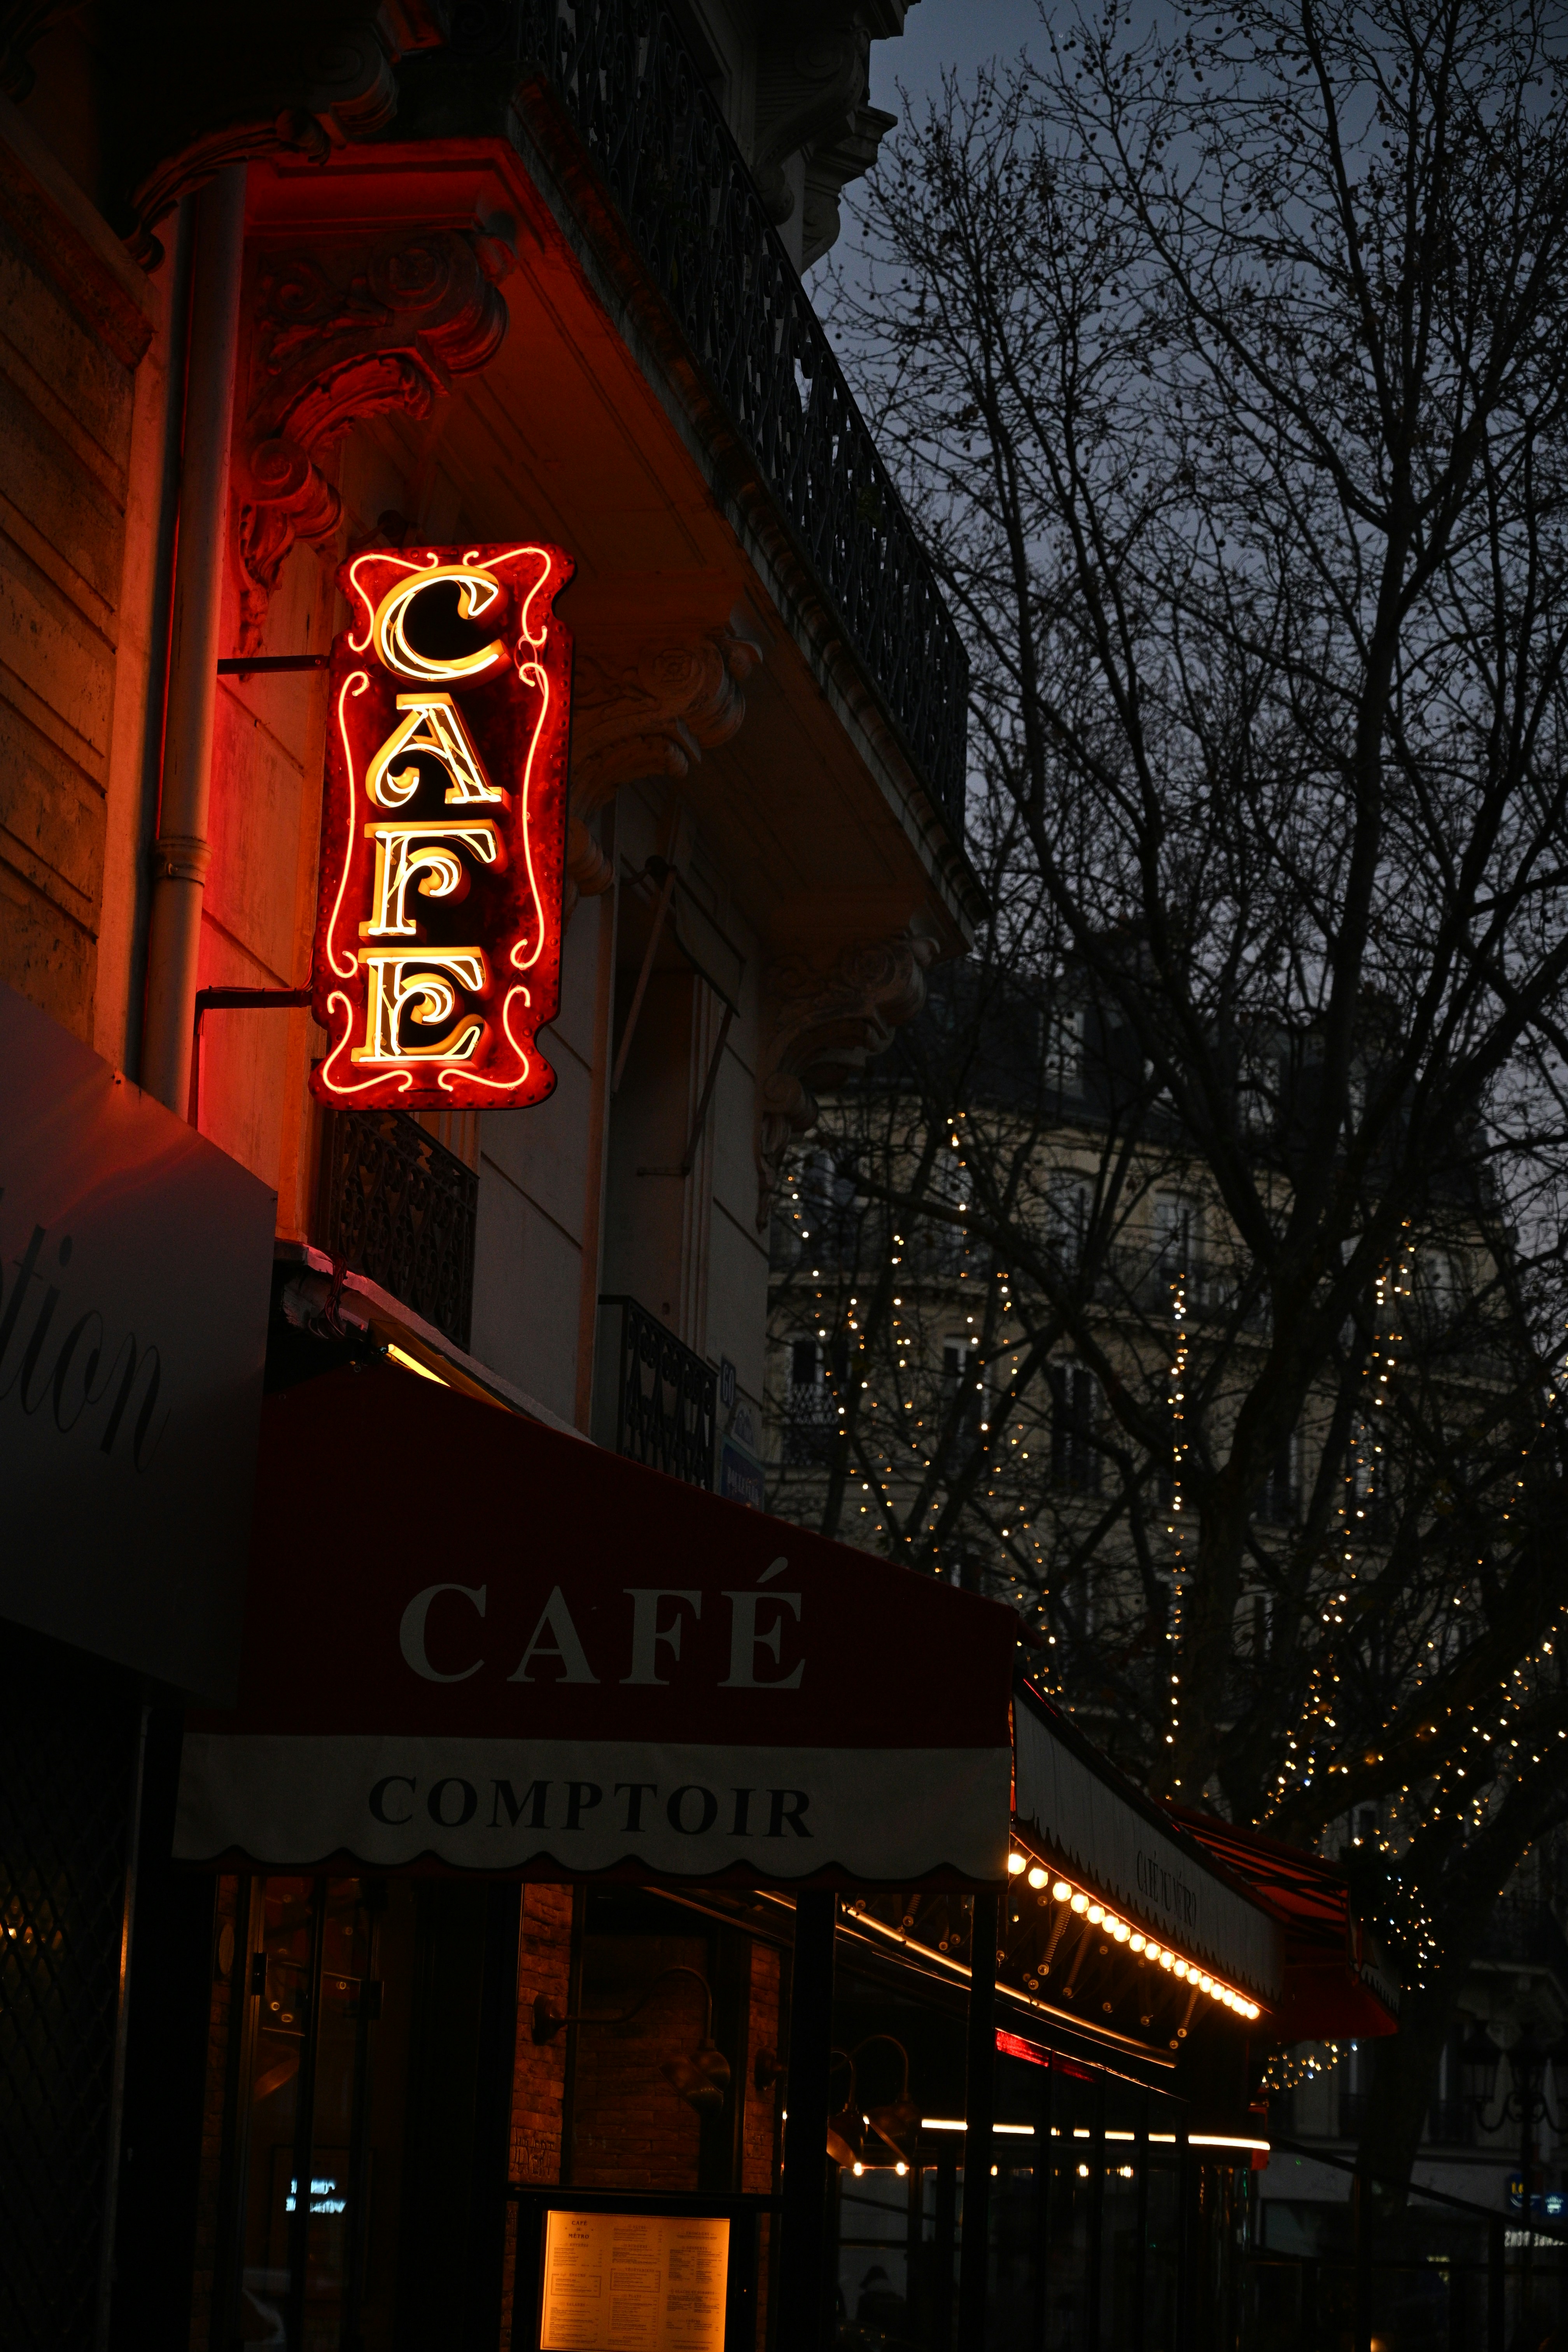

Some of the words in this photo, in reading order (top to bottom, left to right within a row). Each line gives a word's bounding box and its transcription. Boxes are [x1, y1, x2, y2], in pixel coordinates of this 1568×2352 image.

[349, 564, 512, 1069] CAFE
[0, 1187, 172, 1474] tion
[398, 1556, 807, 1690] CAFÉ
[368, 1774, 814, 1838] COMPTOIR
[1136, 1850, 1158, 1902] CAFÉ
[1160, 1869, 1171, 1911] DU
[1172, 1871, 1197, 1930] MÉTRO
